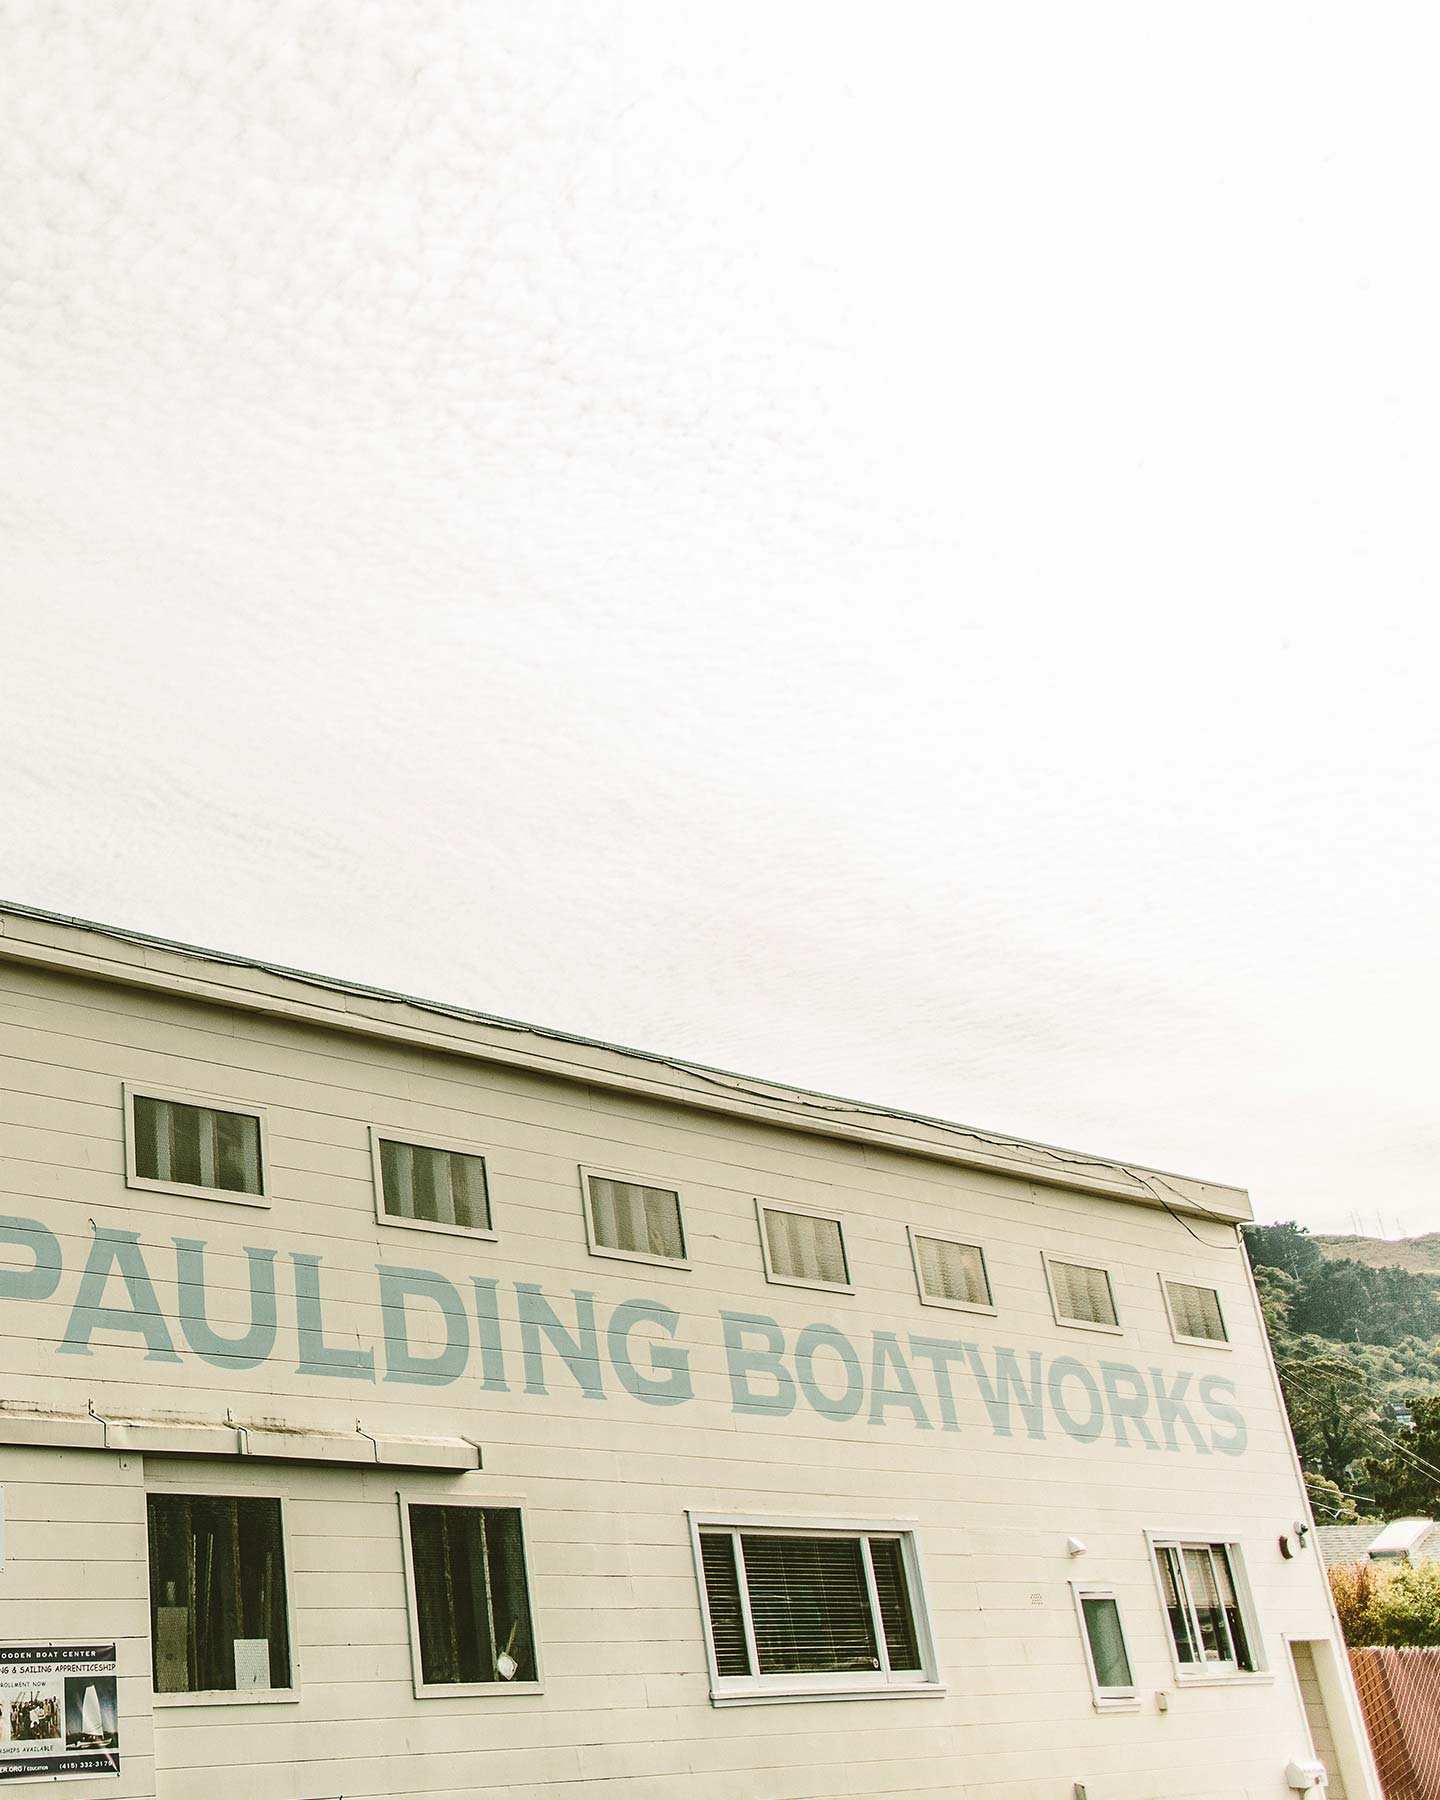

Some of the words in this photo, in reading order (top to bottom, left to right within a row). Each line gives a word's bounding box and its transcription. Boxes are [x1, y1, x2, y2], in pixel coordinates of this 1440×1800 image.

[717, 1308, 1250, 1457] BOATWORKS
[62, 1650, 96, 1658] CENTER
[12, 1666, 17, 1674] &
[20, 1665, 52, 1674] SAILING
[55, 1663, 116, 1672] APPRENTICESHIP
[59, 1762, 78, 1770] (415)
